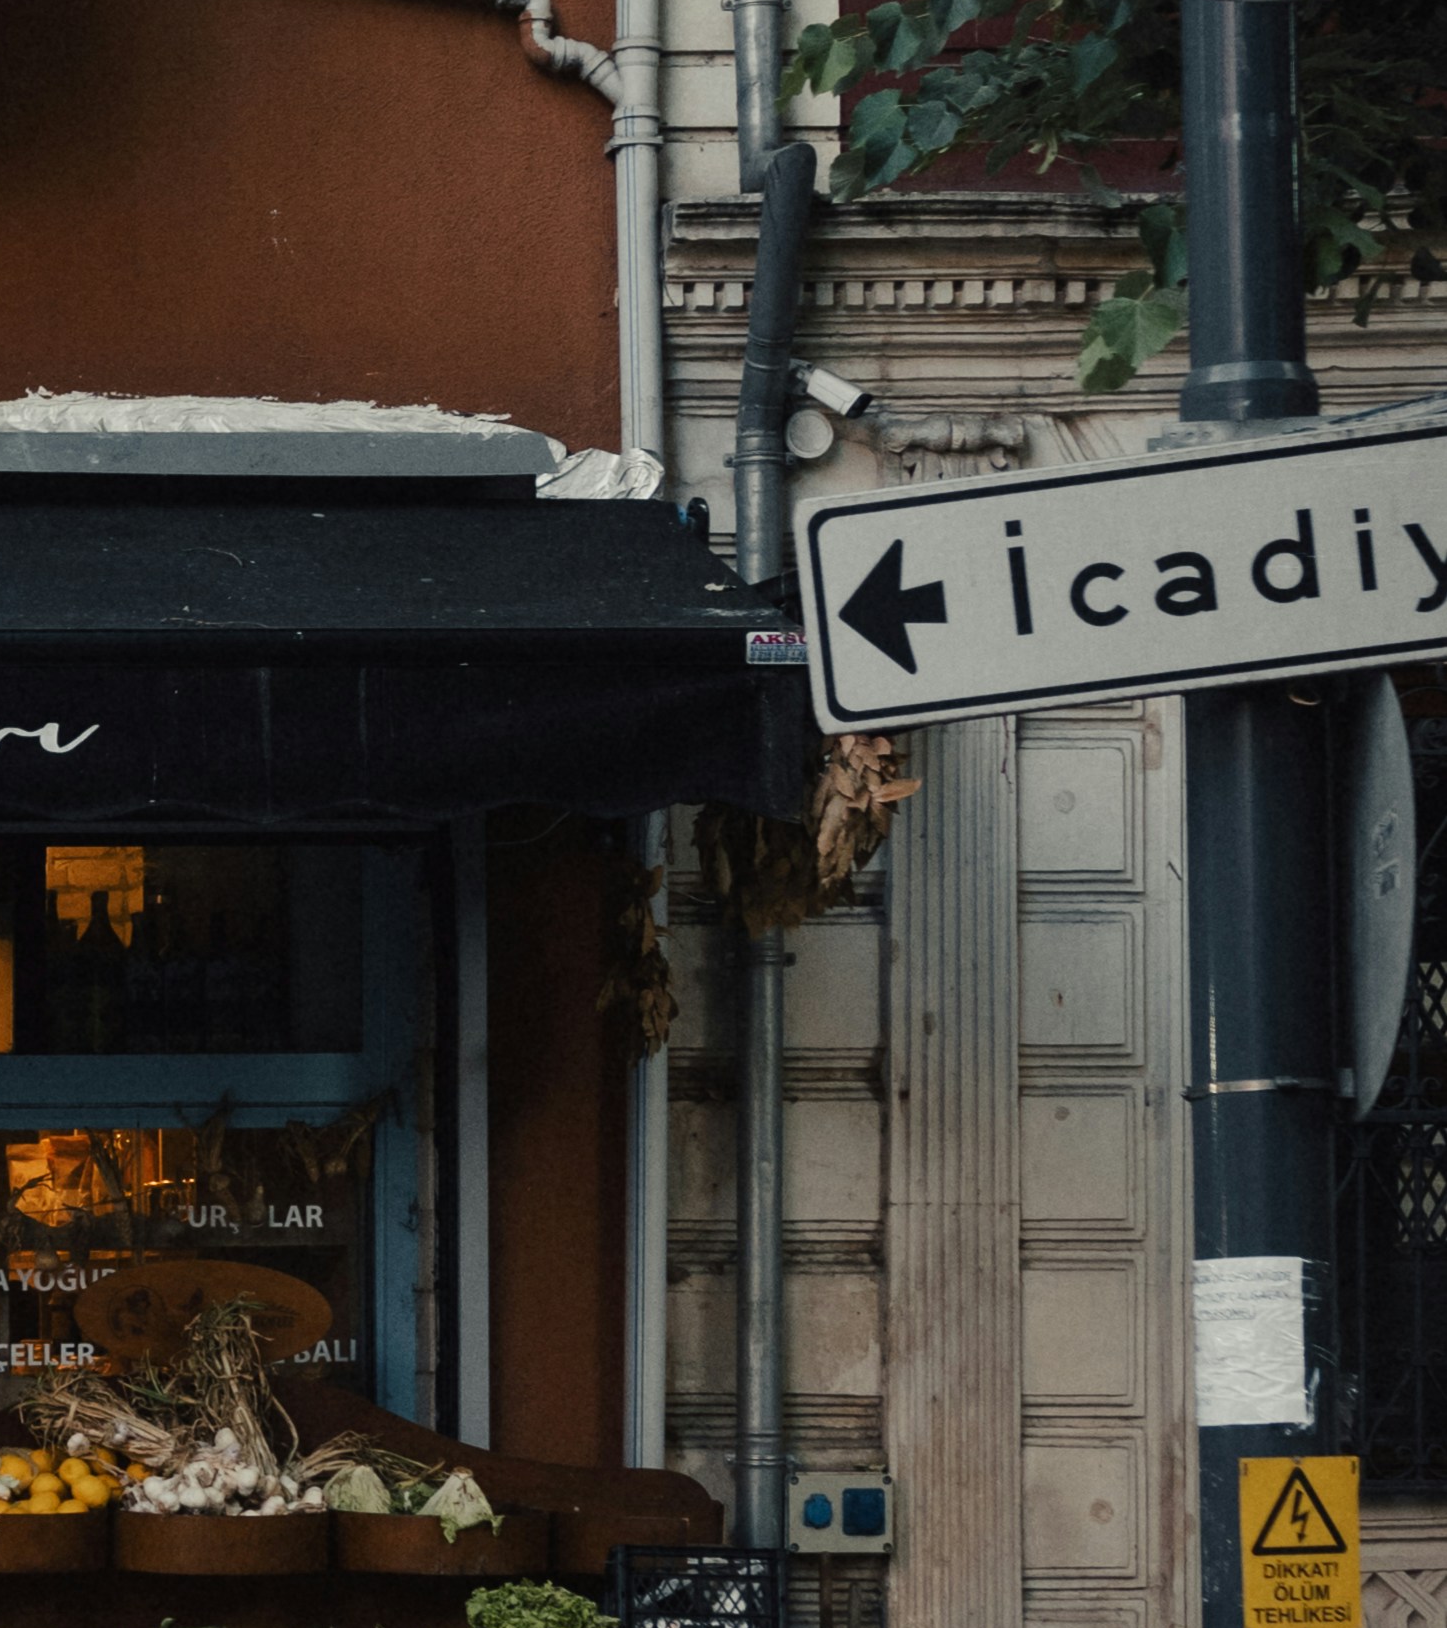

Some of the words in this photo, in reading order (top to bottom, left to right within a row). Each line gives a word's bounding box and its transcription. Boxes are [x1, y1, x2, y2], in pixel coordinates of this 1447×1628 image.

[1263, 1560, 1339, 1579] DİKKAT!
[1273, 1581, 1330, 1602] ÖLÜM
[1252, 1602, 1352, 1624] TEHLİKESİ
